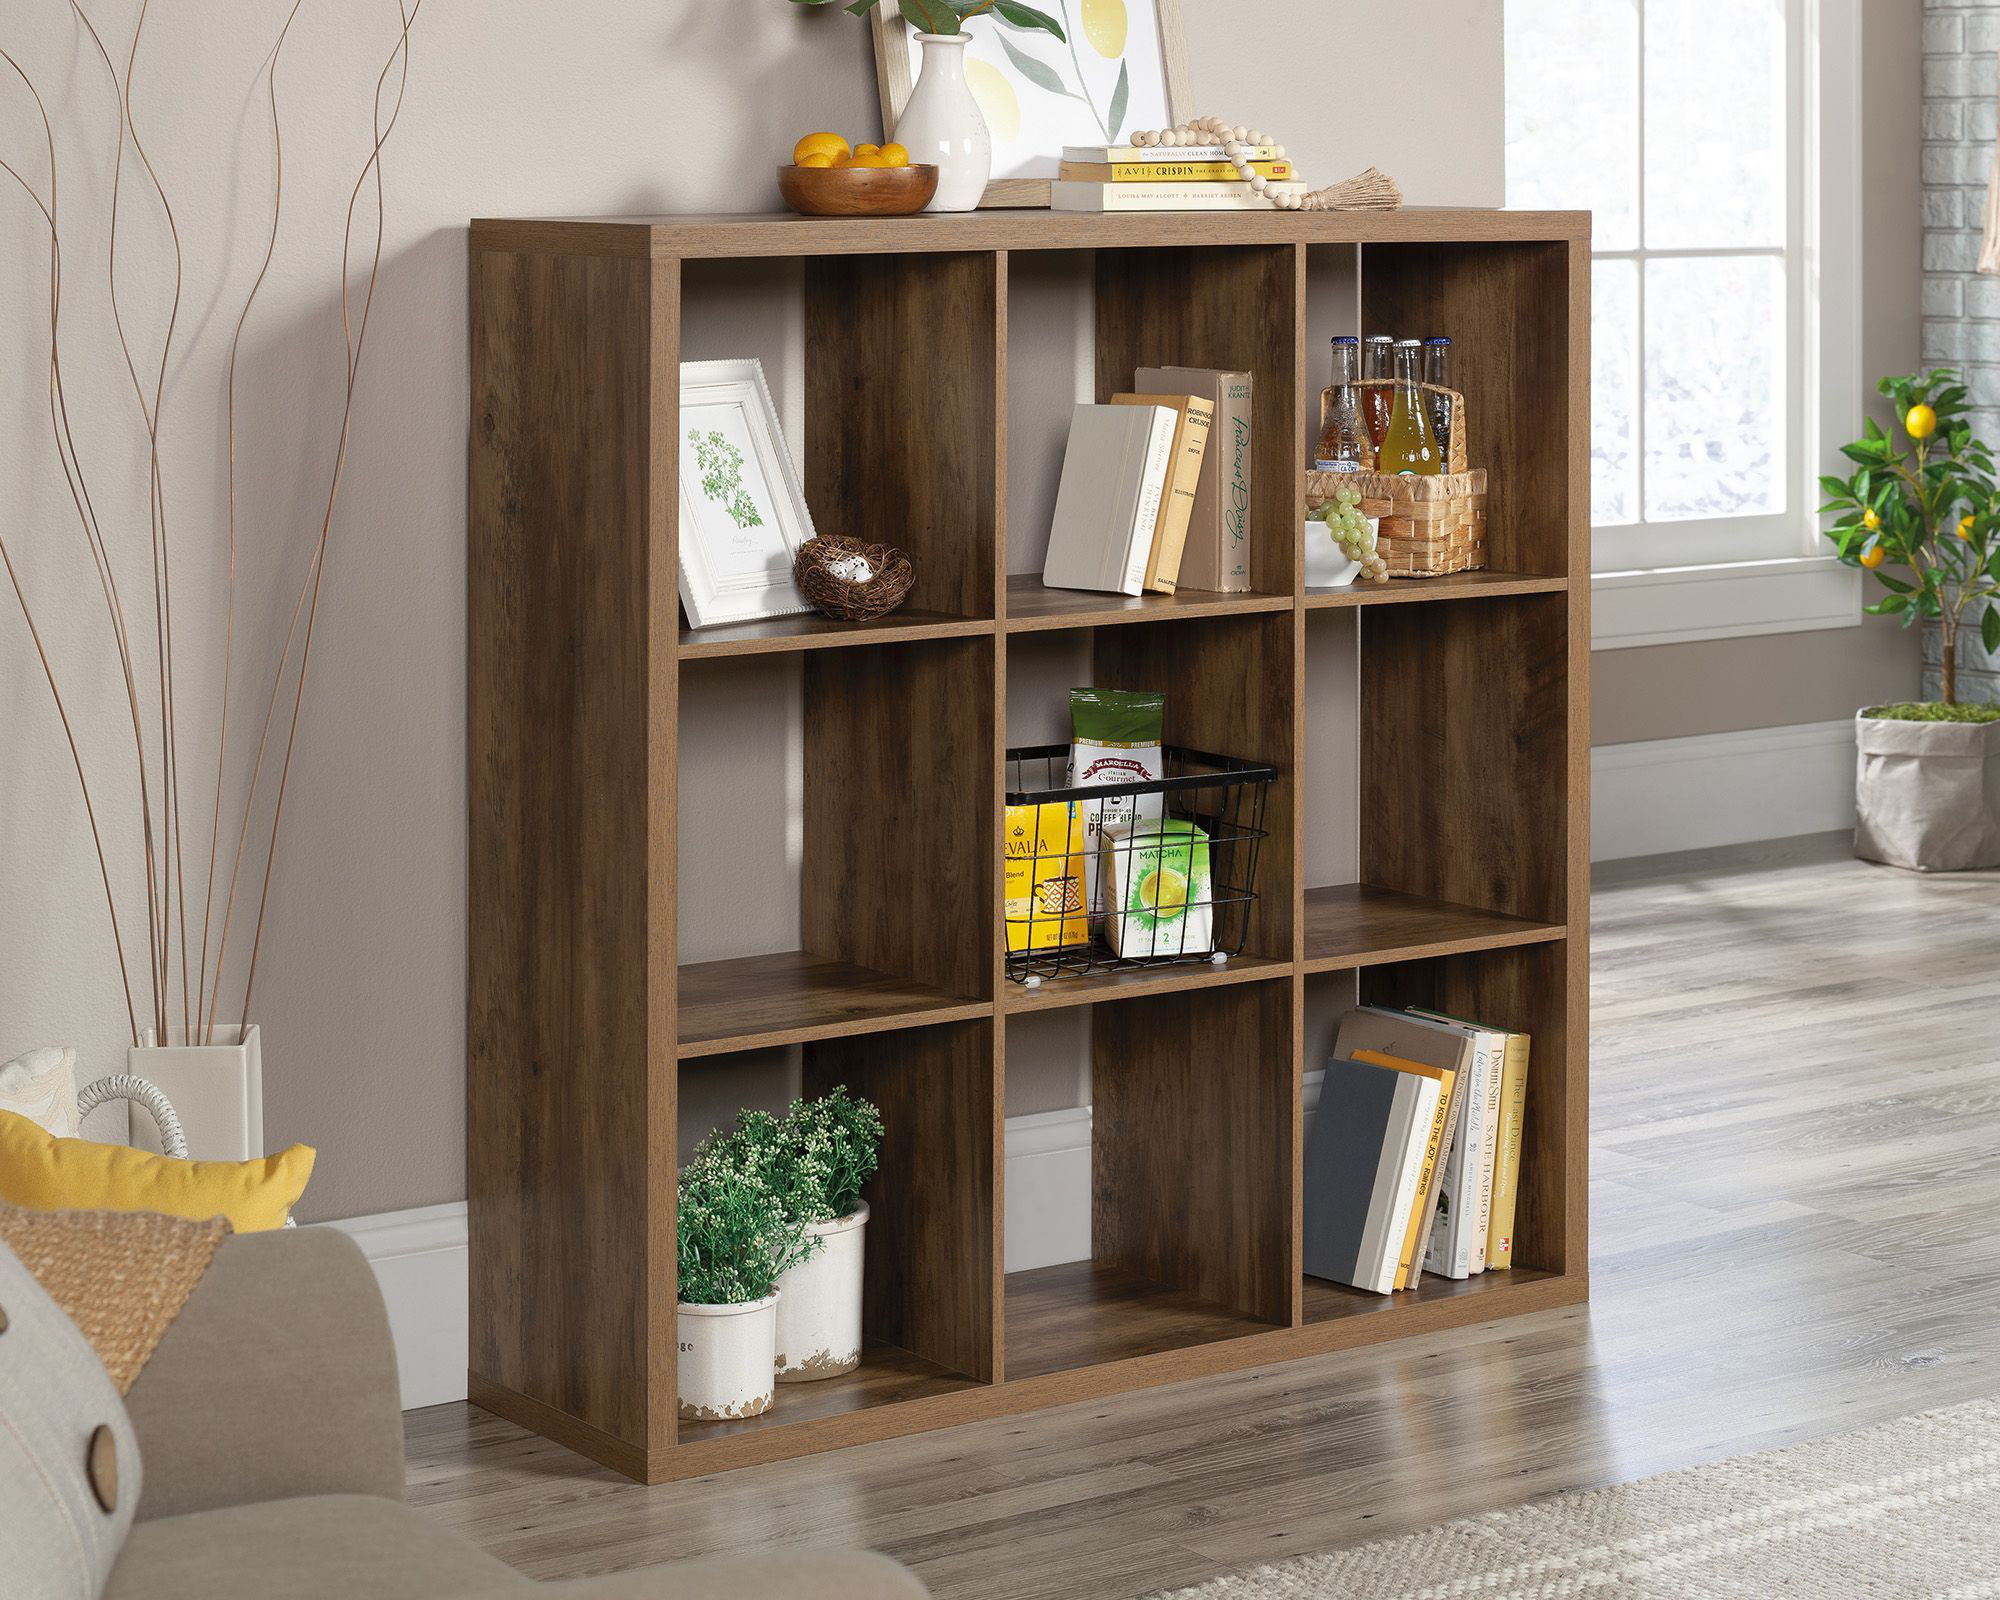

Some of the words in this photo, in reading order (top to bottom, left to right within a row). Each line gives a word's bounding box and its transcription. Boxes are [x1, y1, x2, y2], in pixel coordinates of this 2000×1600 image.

[1124, 167, 1145, 175] AVI
[1156, 166, 1193, 176] CRISPIN
[1187, 407, 1212, 419] ROBINSO
[1078, 737, 1104, 746] PREMIUM
[1130, 740, 1156, 748] PREMIUM
[1098, 773, 1136, 783] Gourmet
[1090, 812, 1117, 822] COFEE
[1139, 848, 1182, 860] MATCHA
[1005, 870, 1025, 879] Blend
[1163, 932, 1170, 943] 2
[1454, 1074, 1466, 1108] WINDOW
[1513, 1077, 1525, 1099] The
[1439, 1093, 1449, 1105] TO
[1435, 1106, 1444, 1125] KISS
[1450, 1110, 1457, 1120] ON
[1511, 1101, 1523, 1124] Last
[1431, 1126, 1441, 1143] THE
[1484, 1124, 1494, 1160] SAFE
[1509, 1126, 1520, 1162] Dance
[1427, 1145, 1436, 1161] JOY
[1436, 1122, 1455, 1182] WILLIAMSBURG
[1419, 1167, 1431, 1196] Raines
[1479, 1163, 1491, 1232] HARBOUR
